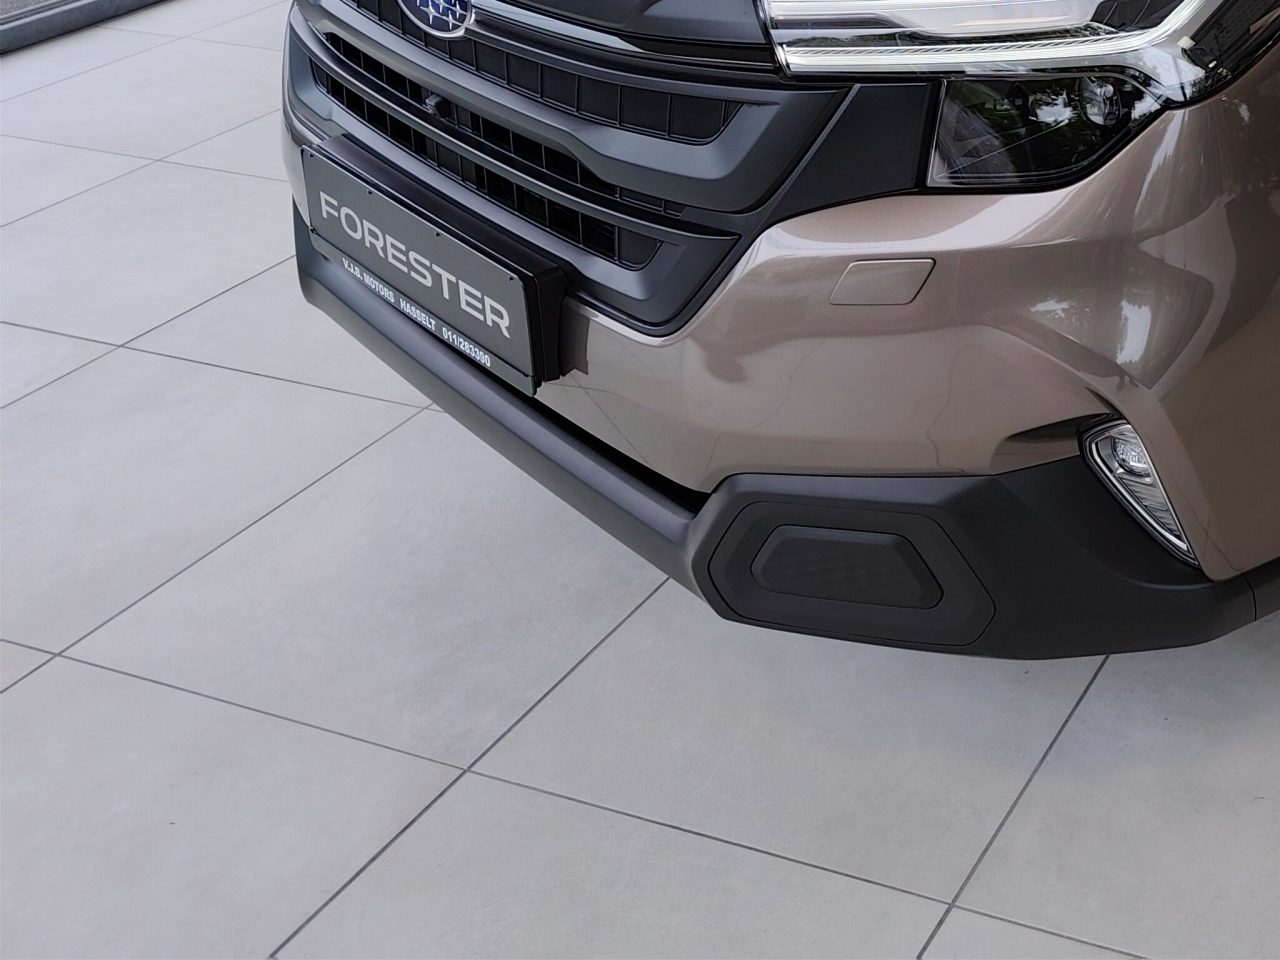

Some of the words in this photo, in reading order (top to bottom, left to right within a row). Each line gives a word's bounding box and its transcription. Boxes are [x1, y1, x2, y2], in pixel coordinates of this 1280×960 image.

[319, 191, 511, 339] FORESTER
[342, 257, 363, 280] V.J.B.
[363, 272, 395, 303] MOTORS
[399, 298, 436, 331] HASSELT
[442, 326, 491, 368] 011/283390
